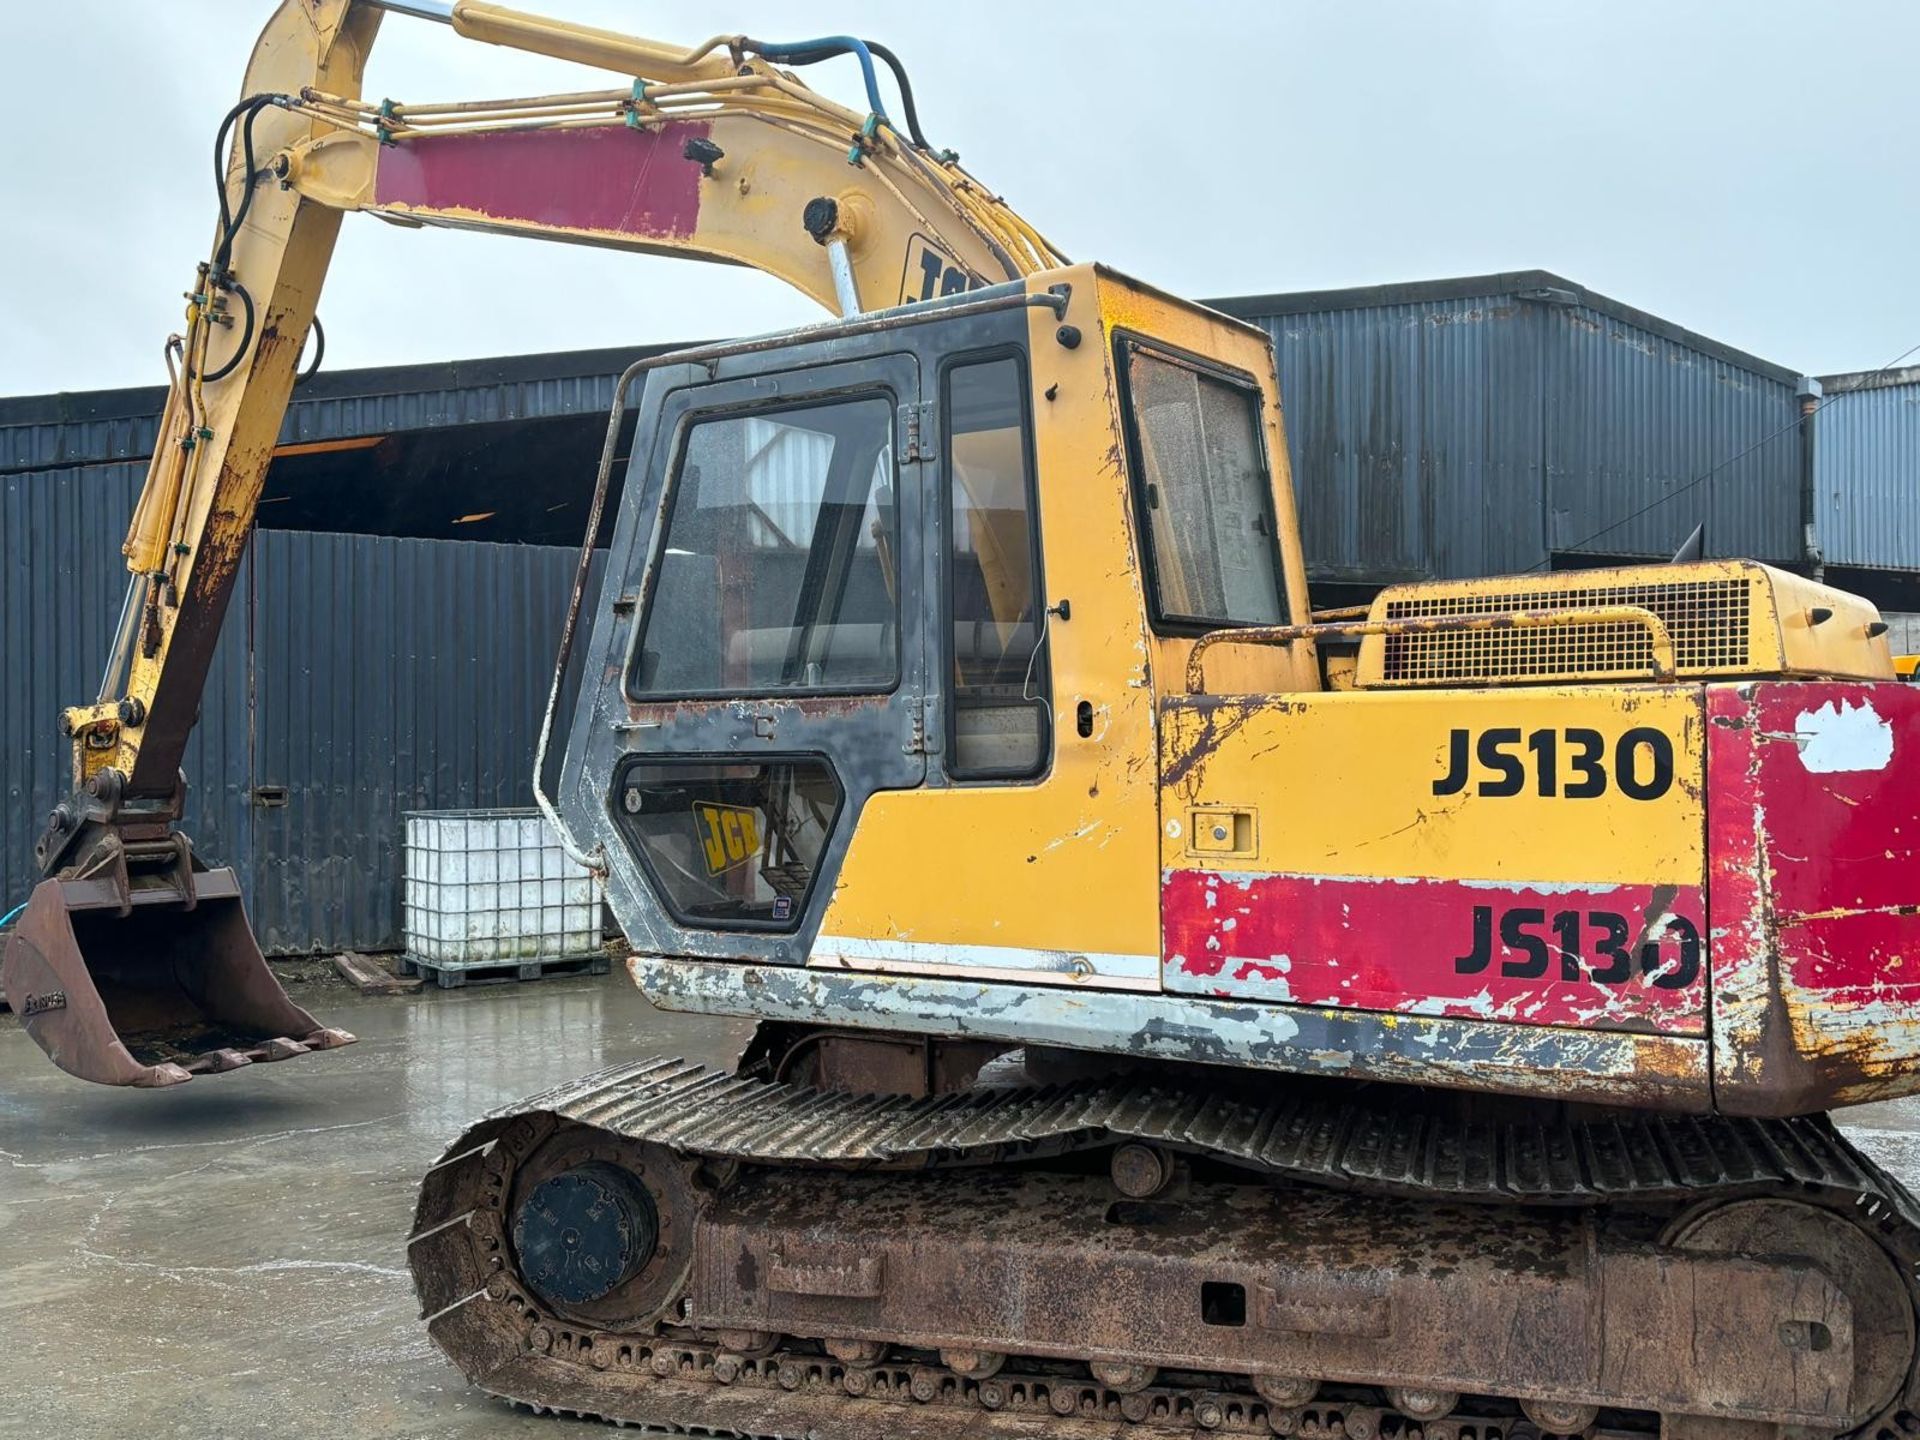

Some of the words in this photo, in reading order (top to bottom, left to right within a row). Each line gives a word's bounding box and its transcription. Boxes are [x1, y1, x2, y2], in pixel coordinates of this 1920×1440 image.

[1432, 727, 1673, 800] JS130
[702, 807, 759, 871] JCB
[1455, 905, 1699, 990] JS130
